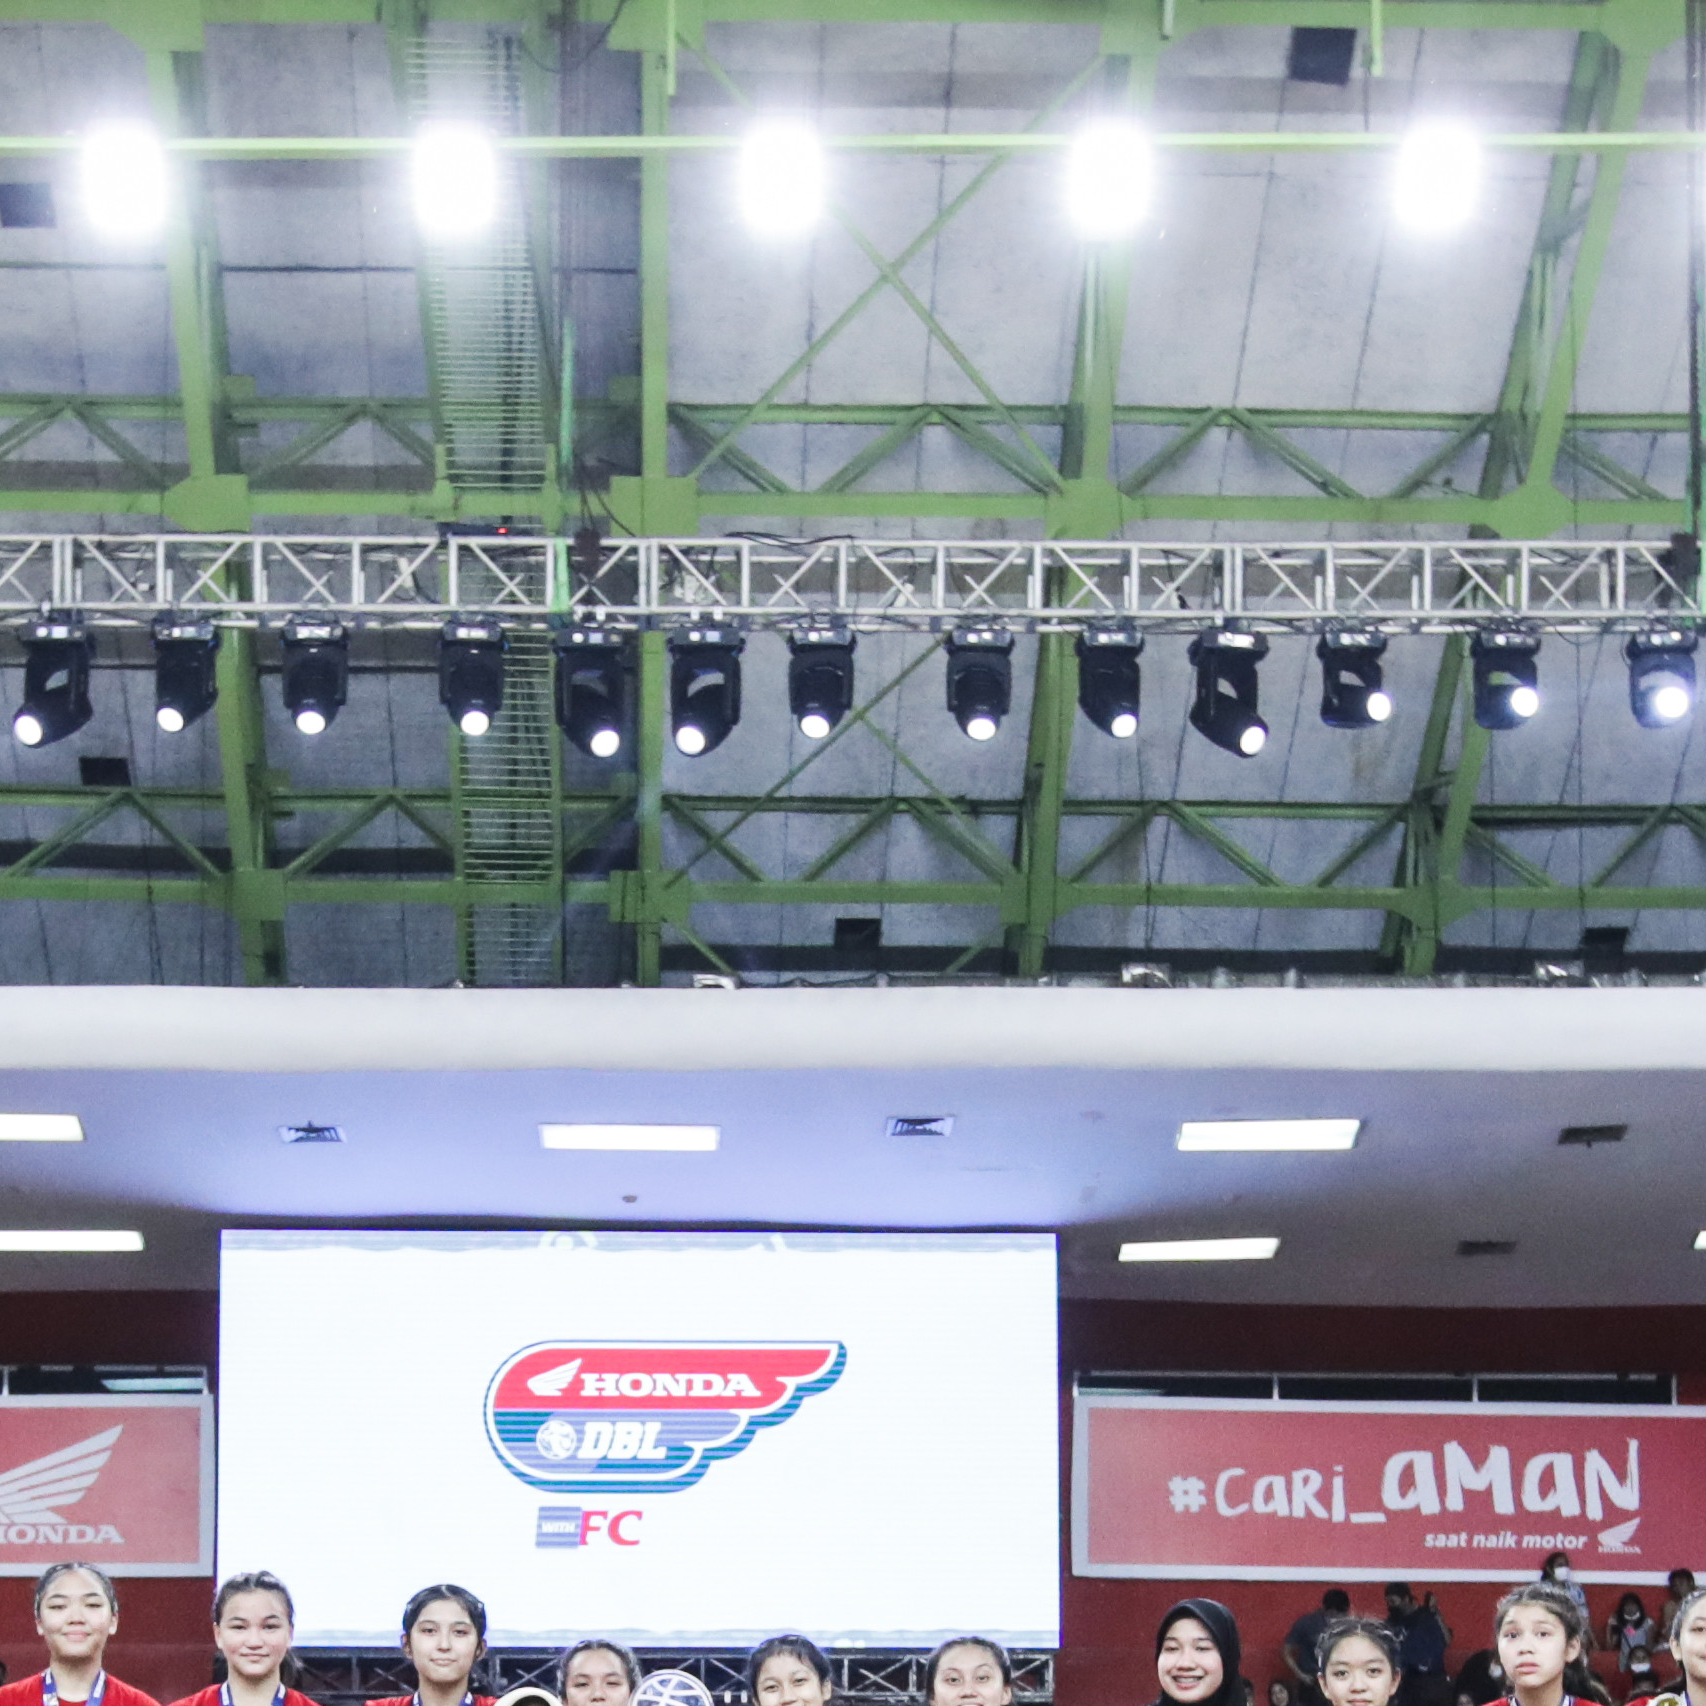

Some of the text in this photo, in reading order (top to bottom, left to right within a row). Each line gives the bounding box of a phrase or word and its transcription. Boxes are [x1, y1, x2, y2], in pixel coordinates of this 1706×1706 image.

[580, 1373, 761, 1397] HONDA
[577, 1421, 667, 1459] DBL
[1424, 1530, 1588, 1549] saat naik motor
